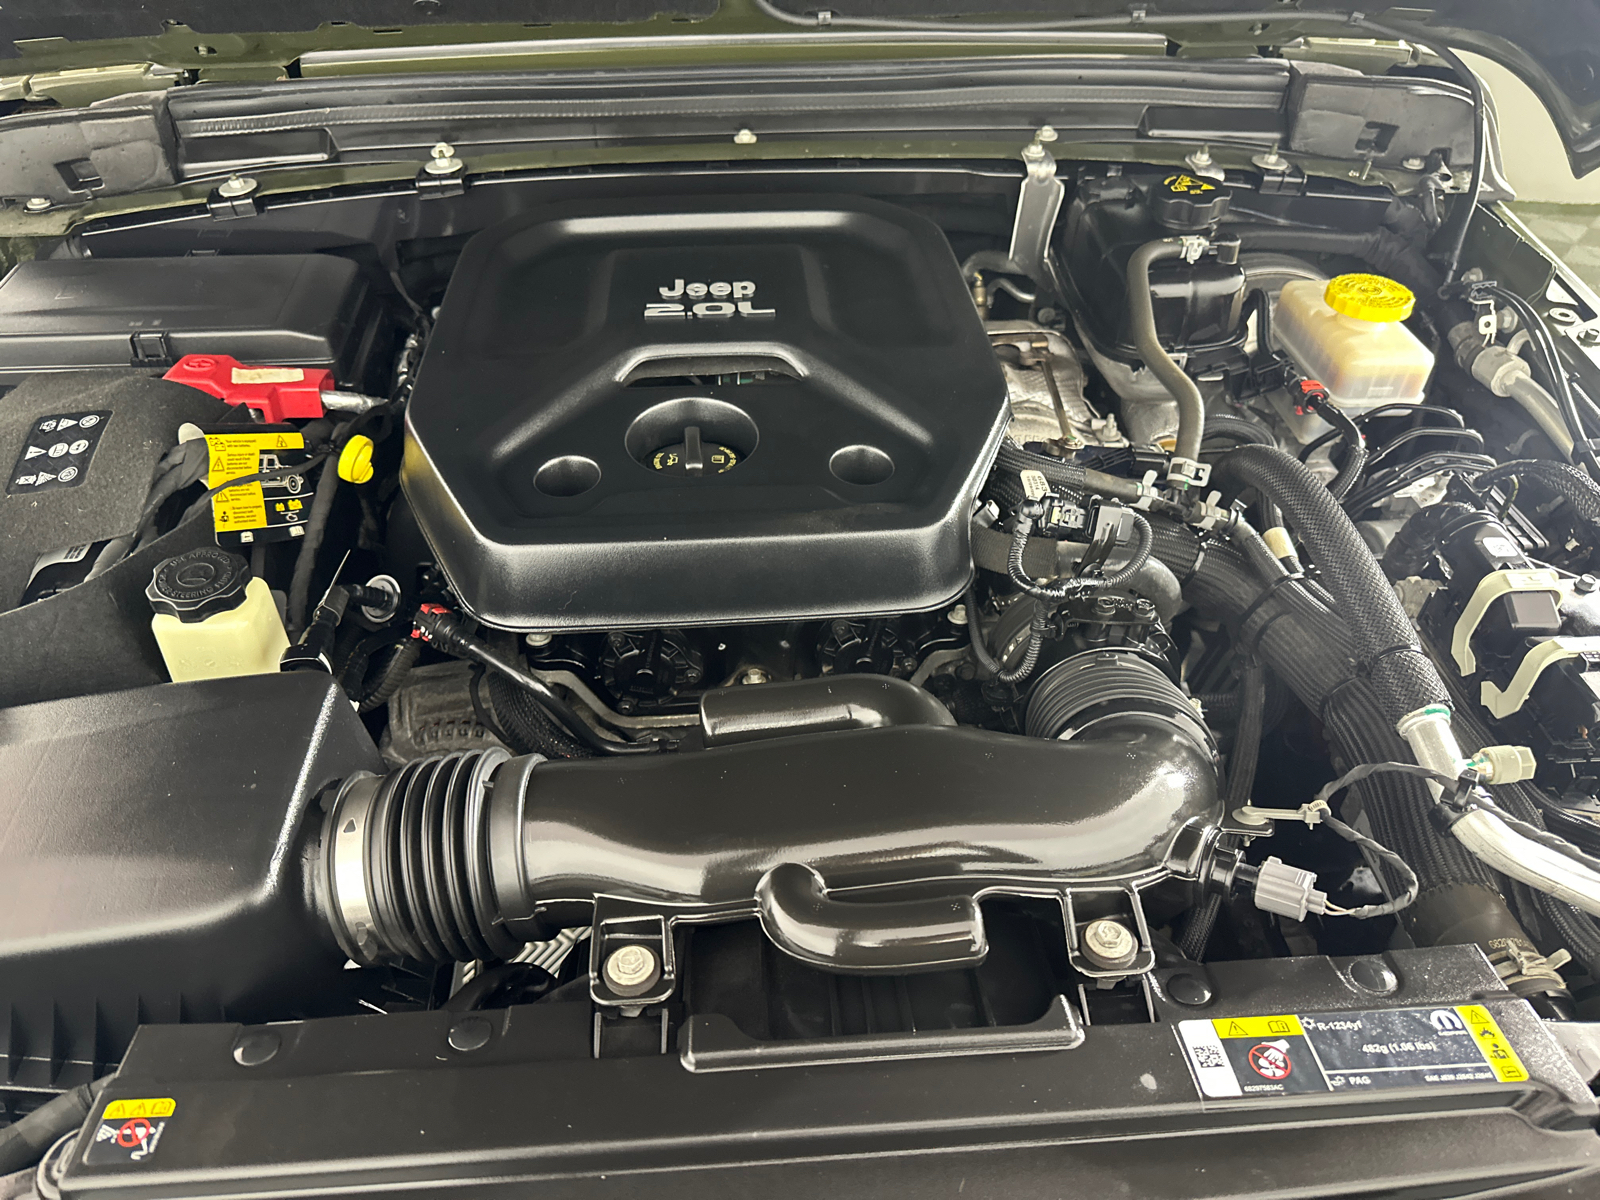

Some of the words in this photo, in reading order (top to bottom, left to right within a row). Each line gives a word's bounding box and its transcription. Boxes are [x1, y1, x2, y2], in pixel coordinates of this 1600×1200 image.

[659, 278, 756, 299] Jeep
[644, 301, 776, 318] 2.0L
[169, 556, 188, 567] USE
[188, 551, 231, 564] APPROVED
[171, 586, 214, 599] STEERING
[214, 571, 232, 588] FLUID
[1316, 1020, 1363, 1032] R-1234yf
[1362, 1043, 1390, 1055] 482g
[1348, 1075, 1372, 1086] PAG
